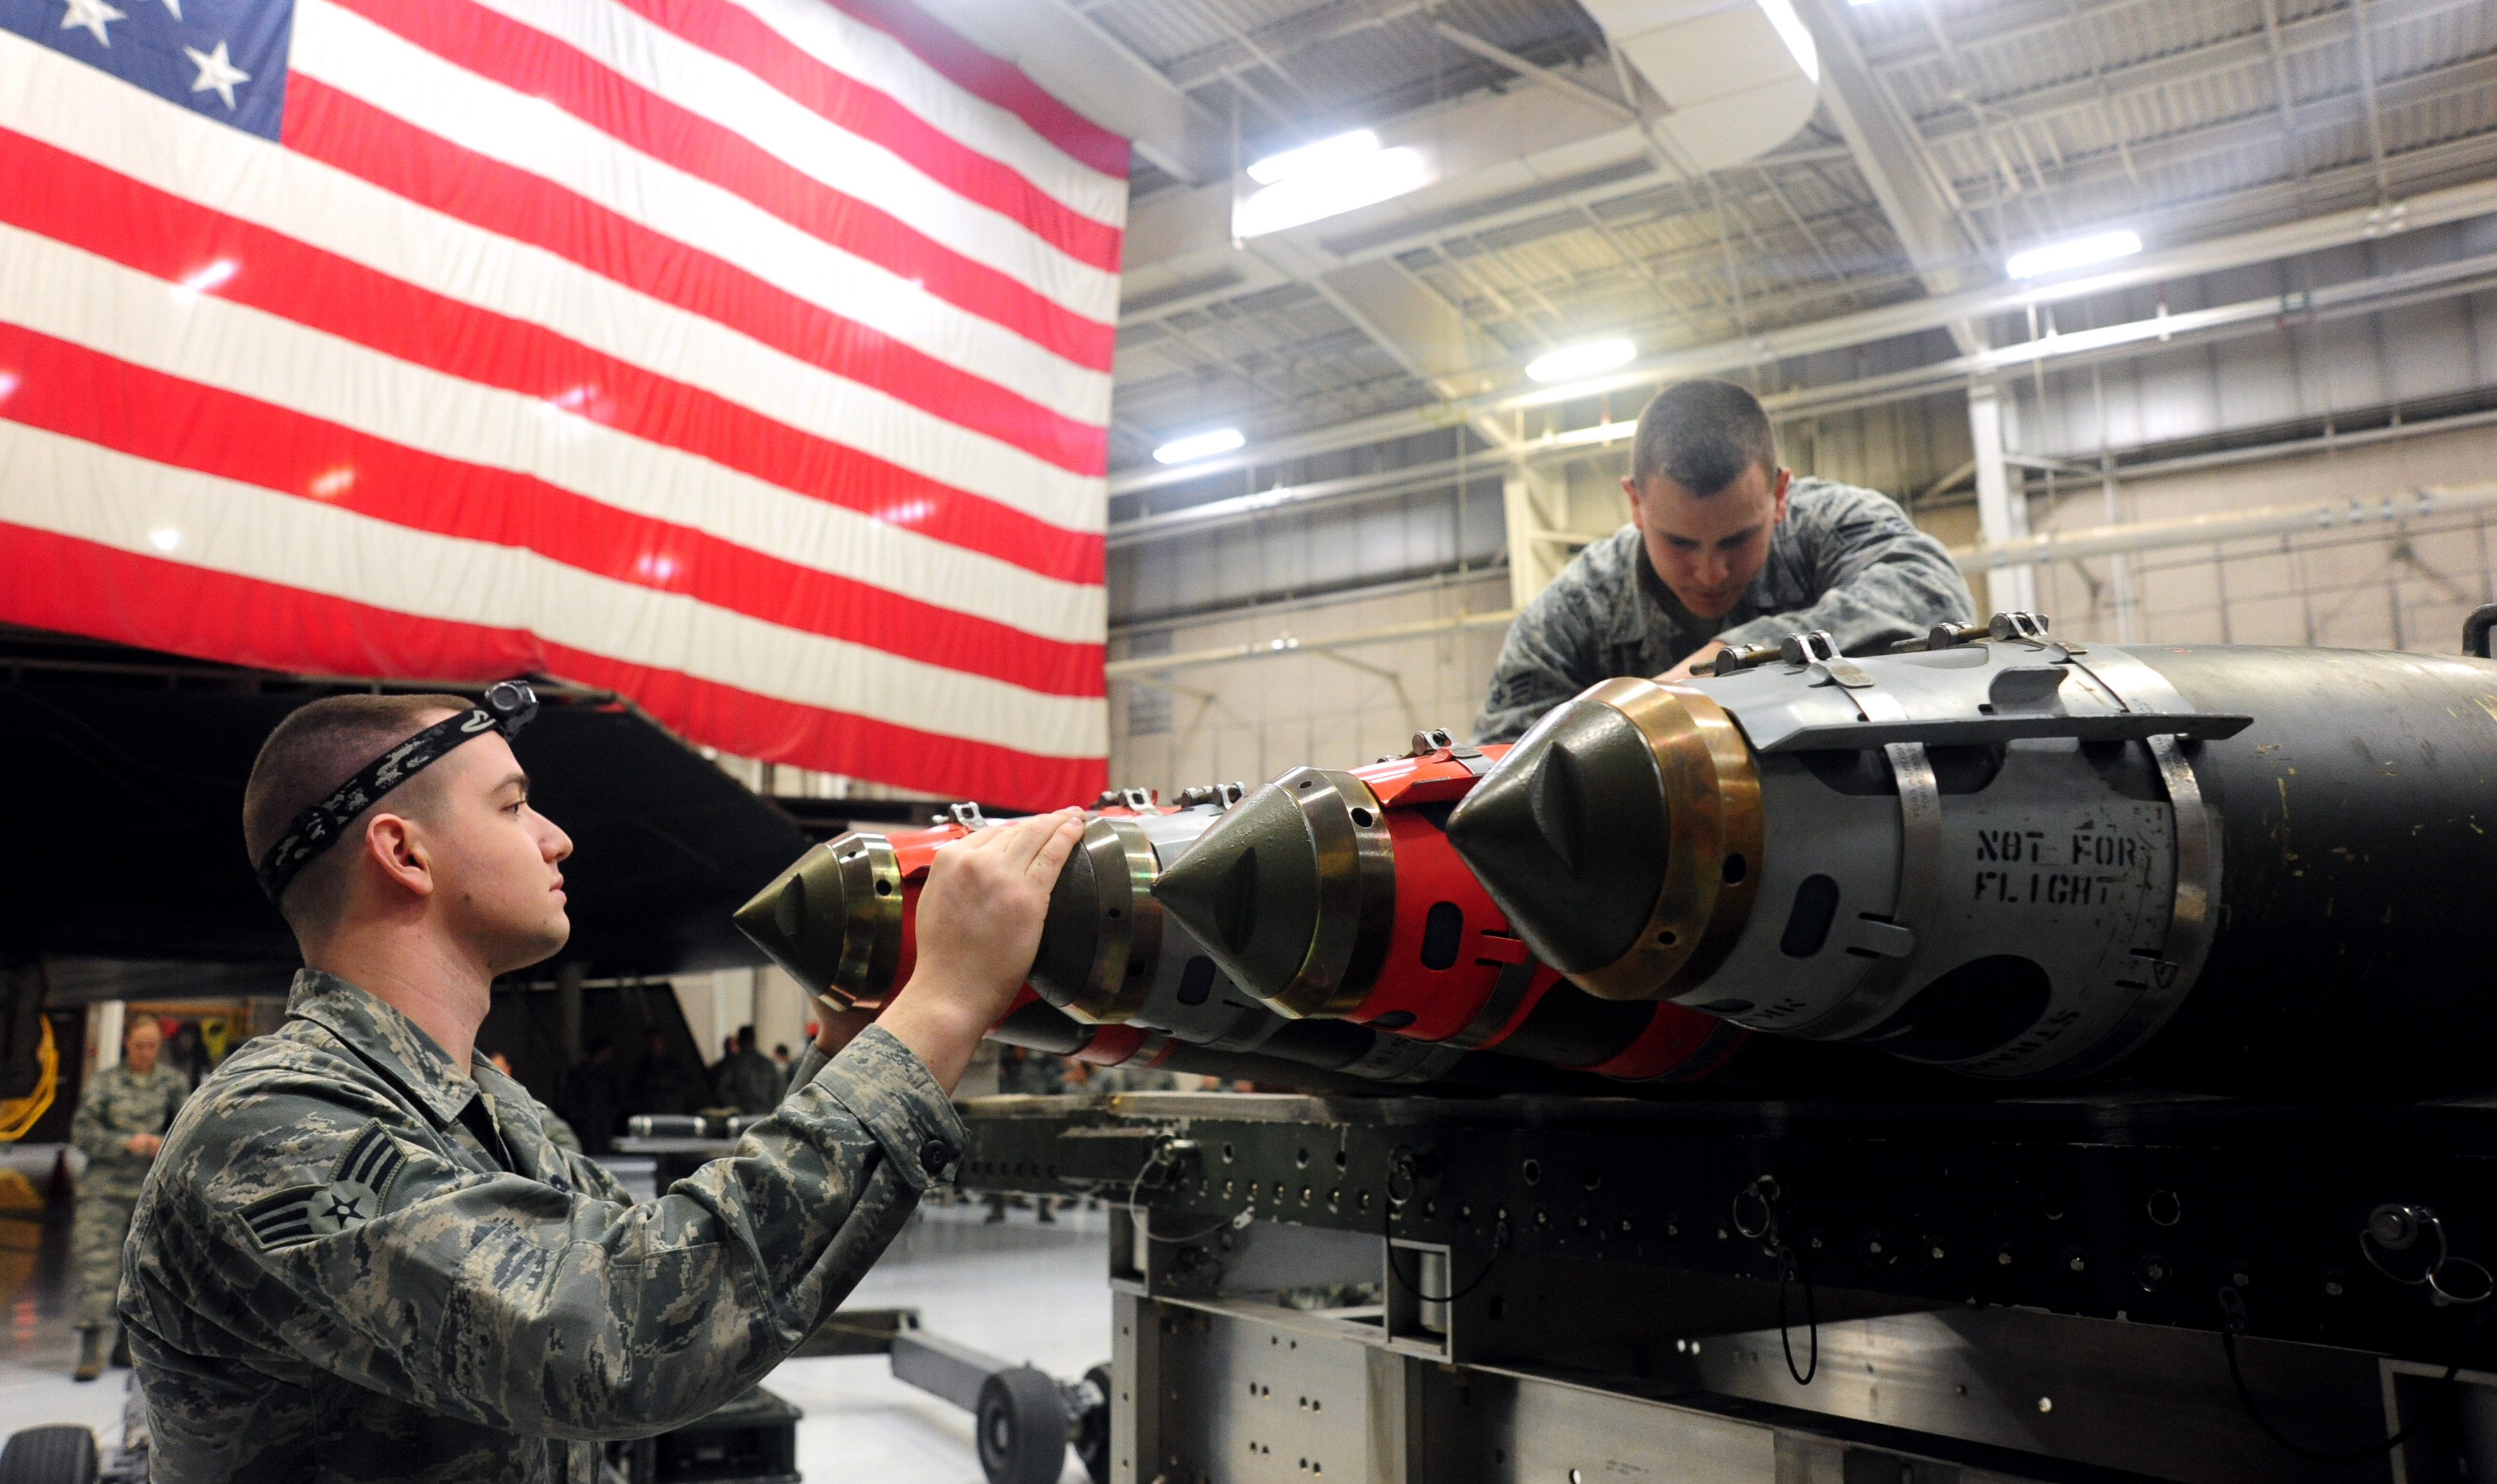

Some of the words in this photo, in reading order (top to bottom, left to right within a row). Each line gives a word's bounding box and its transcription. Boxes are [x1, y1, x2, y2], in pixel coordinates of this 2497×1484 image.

[1976, 830, 2045, 862] NOT
[2073, 834, 2136, 866] FOR
[1975, 871, 2115, 905] FLIGHT
